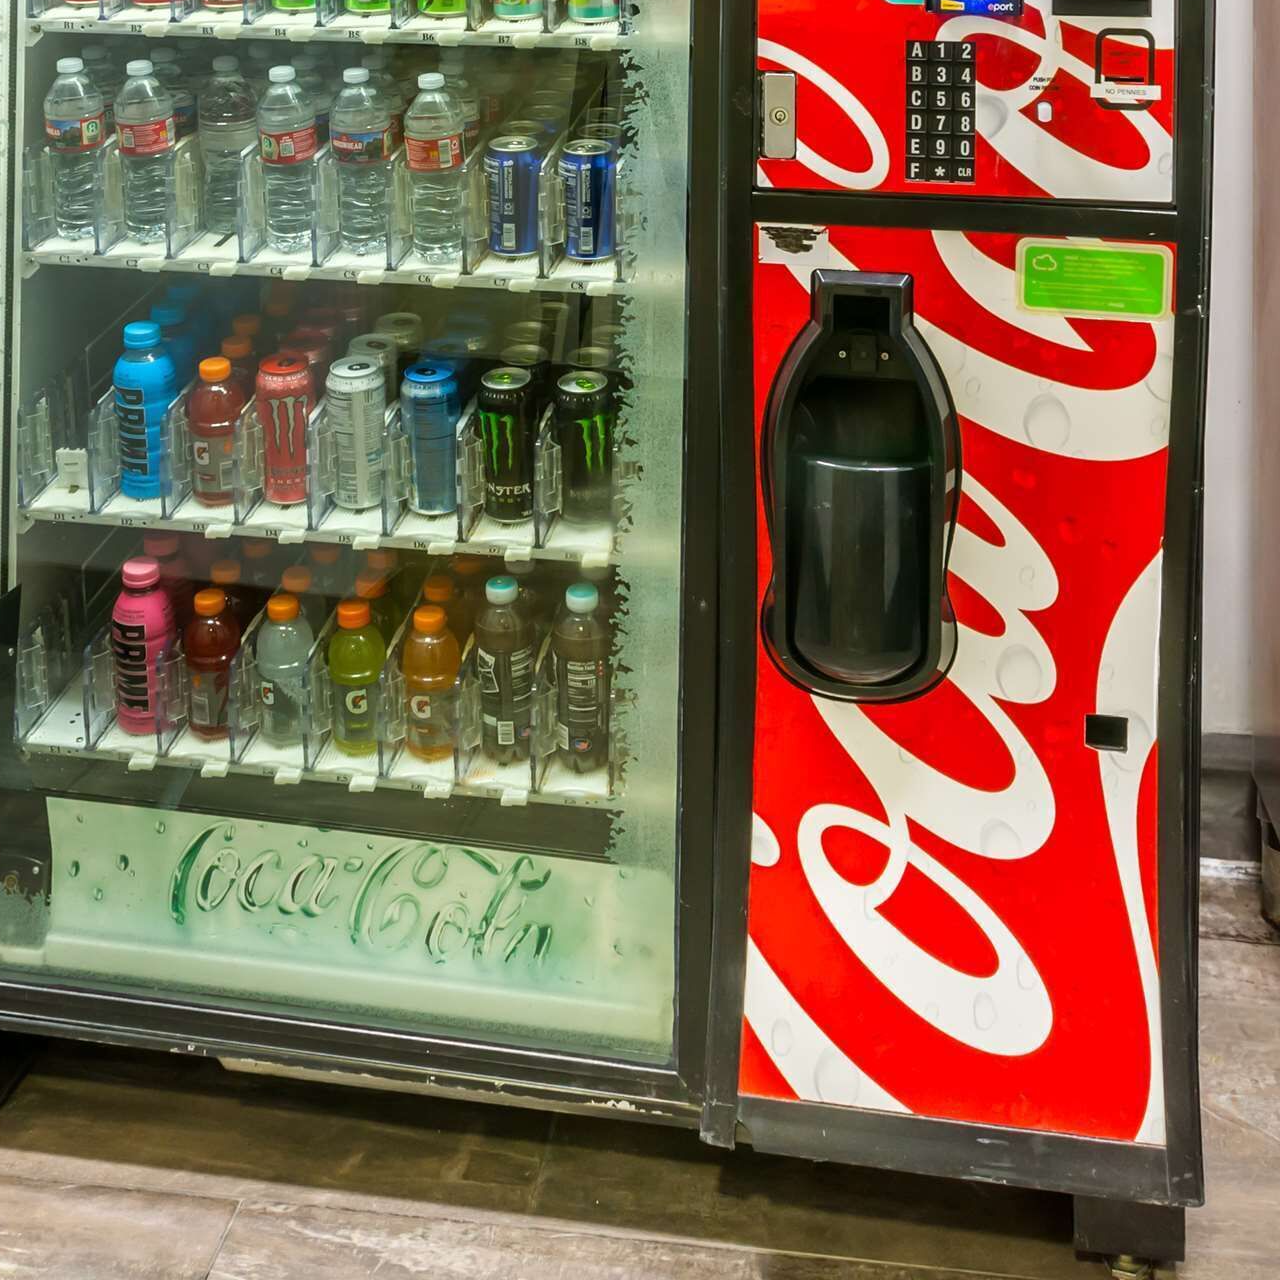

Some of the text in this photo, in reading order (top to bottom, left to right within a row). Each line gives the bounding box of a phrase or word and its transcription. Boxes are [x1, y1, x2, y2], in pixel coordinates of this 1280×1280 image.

[988, 2, 1014, 12] eport
[64, 22, 75, 30] B1
[131, 24, 142, 33] B2
[202, 26, 214, 36] B3
[274, 28, 286, 37] B4
[348, 30, 360, 38] B5
[422, 32, 434, 42] B6
[498, 35, 510, 44] B7
[575, 37, 588, 46] B8
[912, 42, 922, 58] A
[938, 43, 944, 58] 1
[962, 44, 971, 58] 2
[912, 66, 922, 82] B
[937, 67, 946, 82] 3
[962, 68, 970, 83] 4
[912, 90, 921, 106] C
[936, 91, 946, 106] 5
[962, 92, 970, 108] 6
[912, 114, 922, 130] D
[936, 116, 946, 130] 7
[961, 116, 970, 132] 8
[911, 138, 920, 154] E
[936, 140, 945, 155] 9
[960, 140, 970, 156] 0
[910, 163, 920, 178] F
[958, 168, 972, 176] CLR
[126, 258, 138, 266] C2
[270, 268, 282, 276] C4
[344, 270, 356, 279] C5
[418, 274, 430, 283] C6
[494, 278, 506, 287] C7
[571, 281, 584, 290] C8
[338, 535, 351, 544] D5
[346, 689, 368, 714] G
[411, 695, 432, 718] G
